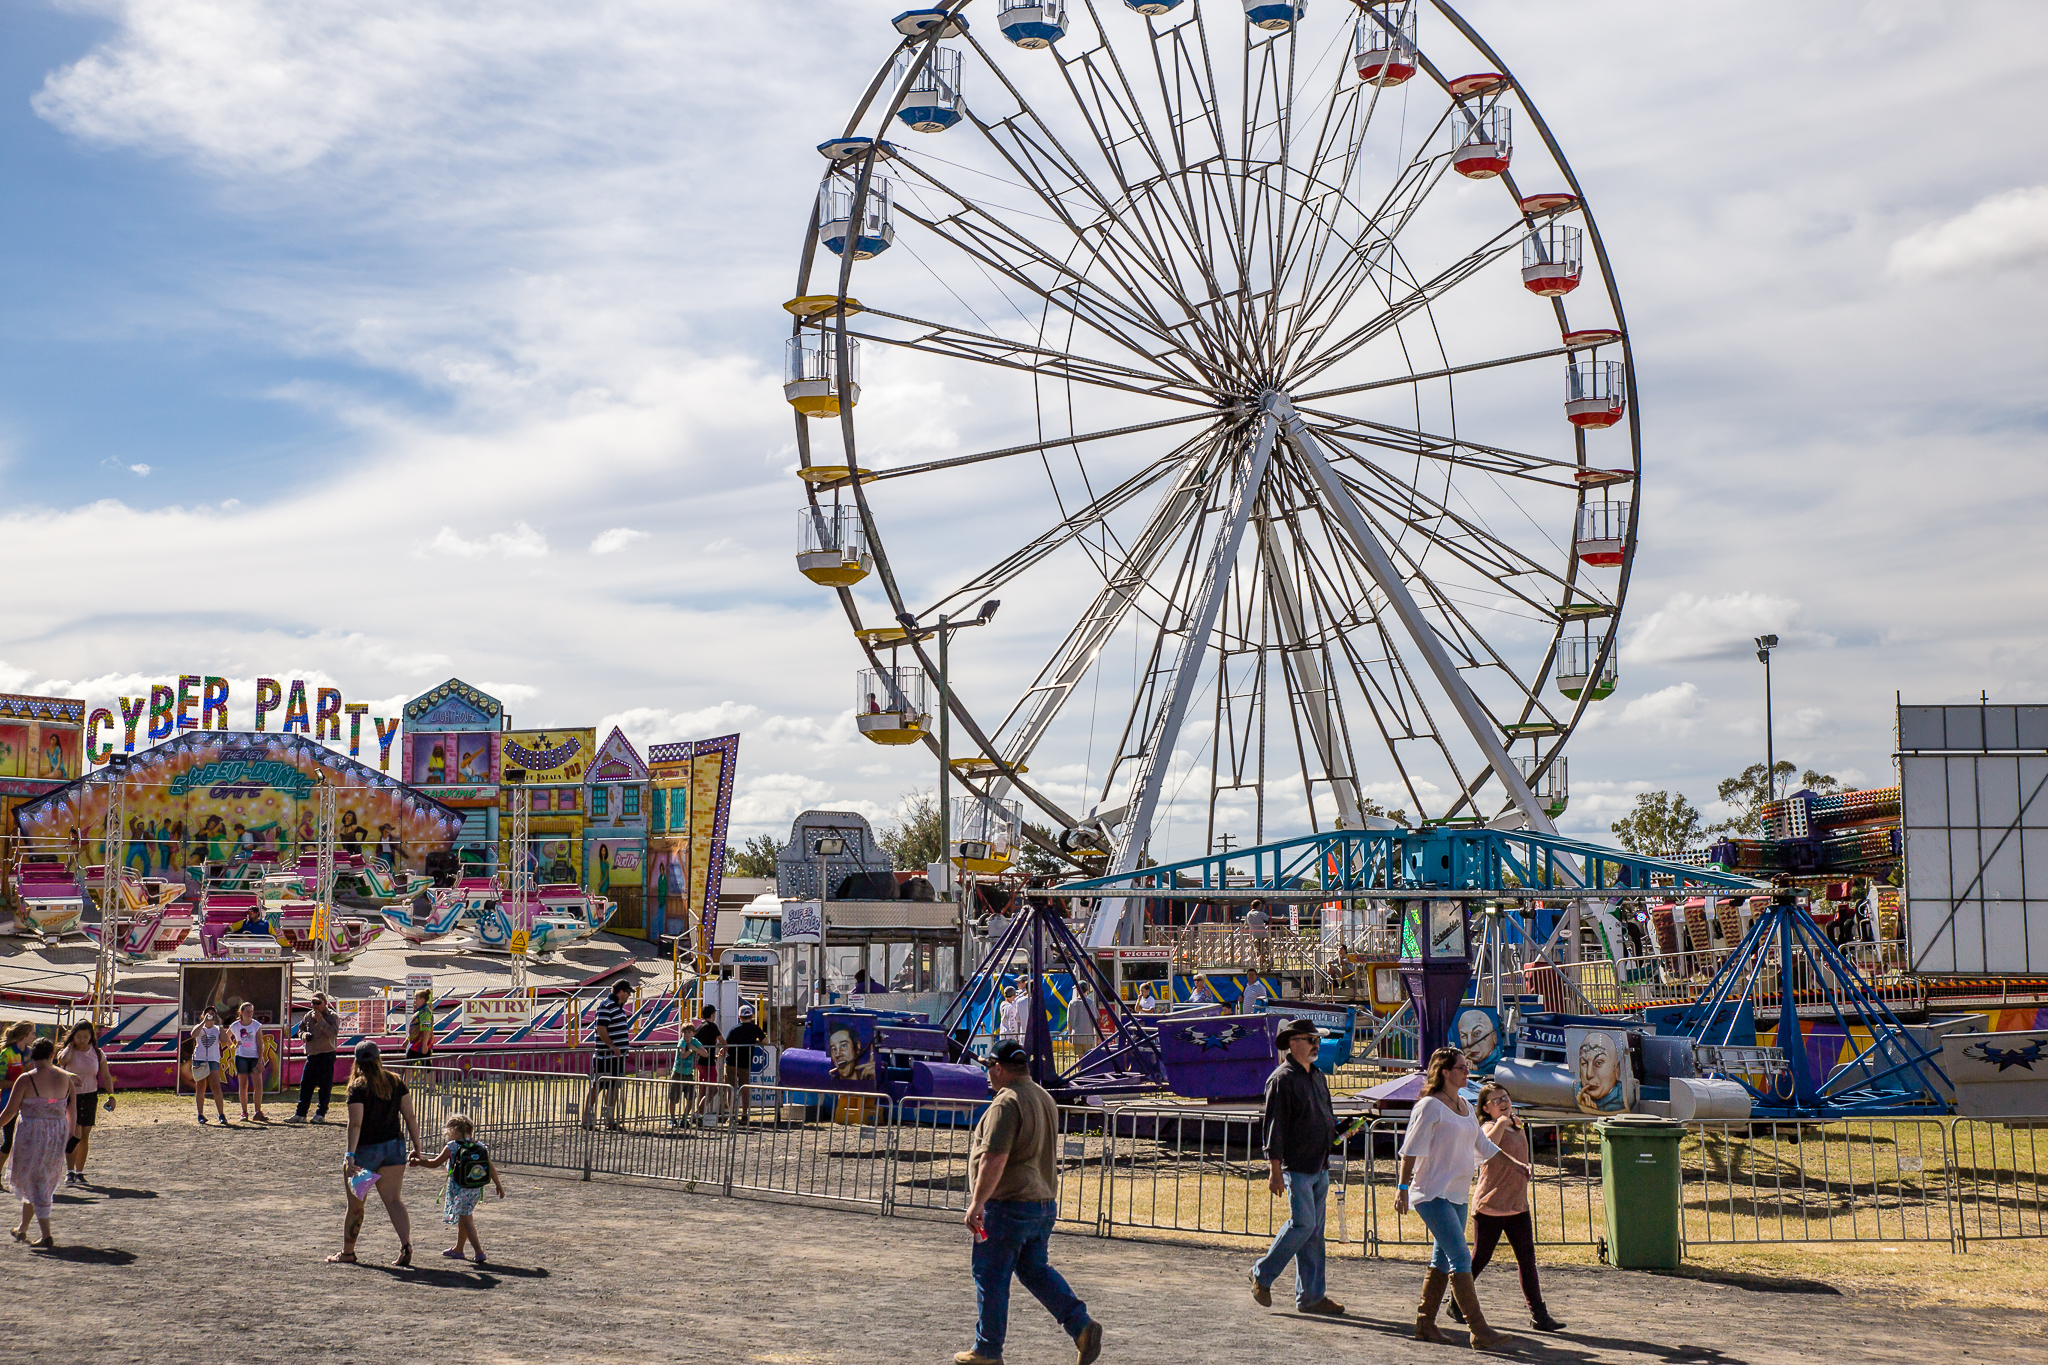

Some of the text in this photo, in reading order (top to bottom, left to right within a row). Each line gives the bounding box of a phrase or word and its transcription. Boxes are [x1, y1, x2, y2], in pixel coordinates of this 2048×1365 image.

[86, 674, 400, 771] CYBER PARTY
[430, 710, 478, 722] LIGHTHOUSE
[220, 750, 267, 760] THE NEW
[210, 781, 269, 800] CAFE
[422, 789, 477, 798] PARKING
[788, 906, 814, 921] SUPER
[781, 915, 821, 936] SCRAMBLER
[732, 953, 768, 963] Entrance
[465, 999, 529, 1014] ENTRY
[1294, 1011, 1340, 1024] AMBLER
[1534, 1028, 1566, 1043] SCRA
[969, 1043, 988, 1055] XIT
